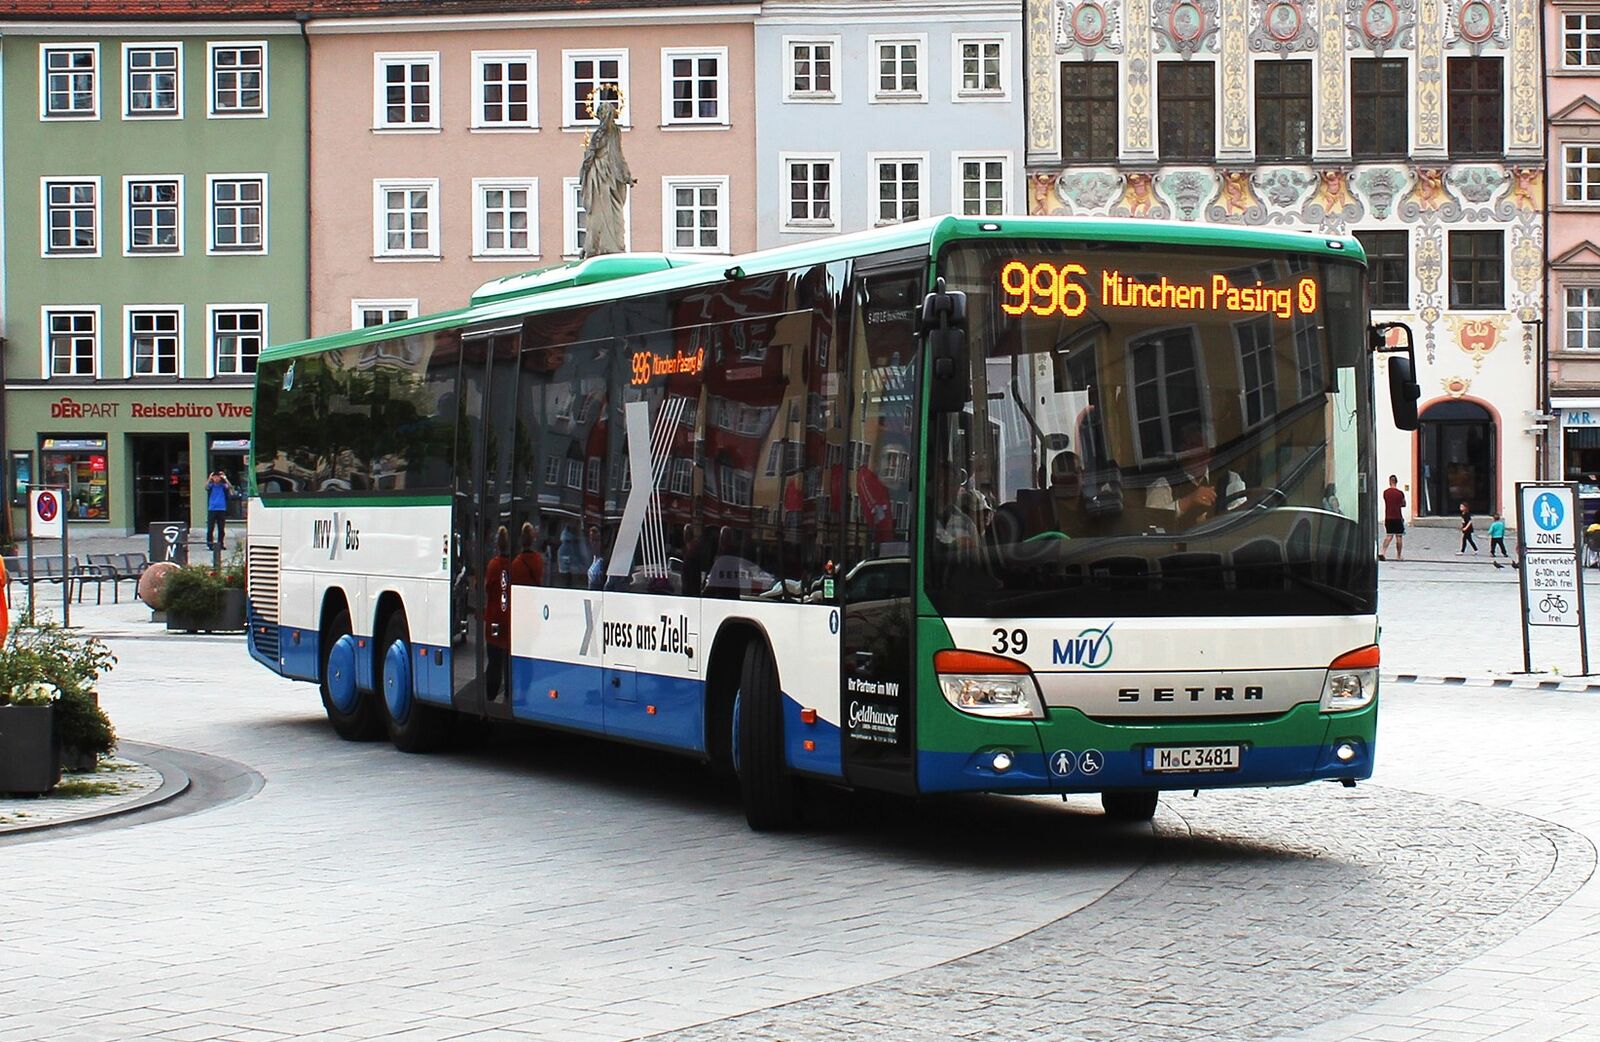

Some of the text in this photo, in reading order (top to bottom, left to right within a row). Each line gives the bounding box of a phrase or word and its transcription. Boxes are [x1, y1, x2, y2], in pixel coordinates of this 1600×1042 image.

[1001, 261, 1088, 318] 996
[1101, 269, 1205, 310] München
[1211, 274, 1291, 319] Pasing
[631, 351, 651, 385] 996
[131, 403, 213, 418] Reisebüro
[313, 520, 332, 549] MVV
[346, 520, 360, 550] Bus
[1536, 533, 1562, 544] ZONE
[1528, 556, 1575, 565] Lieferverkehr
[1535, 568, 1570, 577] 6-10h und
[1533, 579, 1573, 588] 18-20h frei
[1548, 614, 1562, 622] frei
[636, 622, 657, 651] ans
[660, 615, 694, 658] Ziel!
[991, 628, 1028, 655] 39
[1052, 621, 1115, 665] MVV
[856, 679, 877, 693] Partner
[877, 681, 885, 695] im
[886, 682, 899, 697] MVV
[1117, 686, 1263, 703] SETRA
[848, 700, 899, 728] Geldhauser
[1160, 748, 1232, 767] M C 3481
